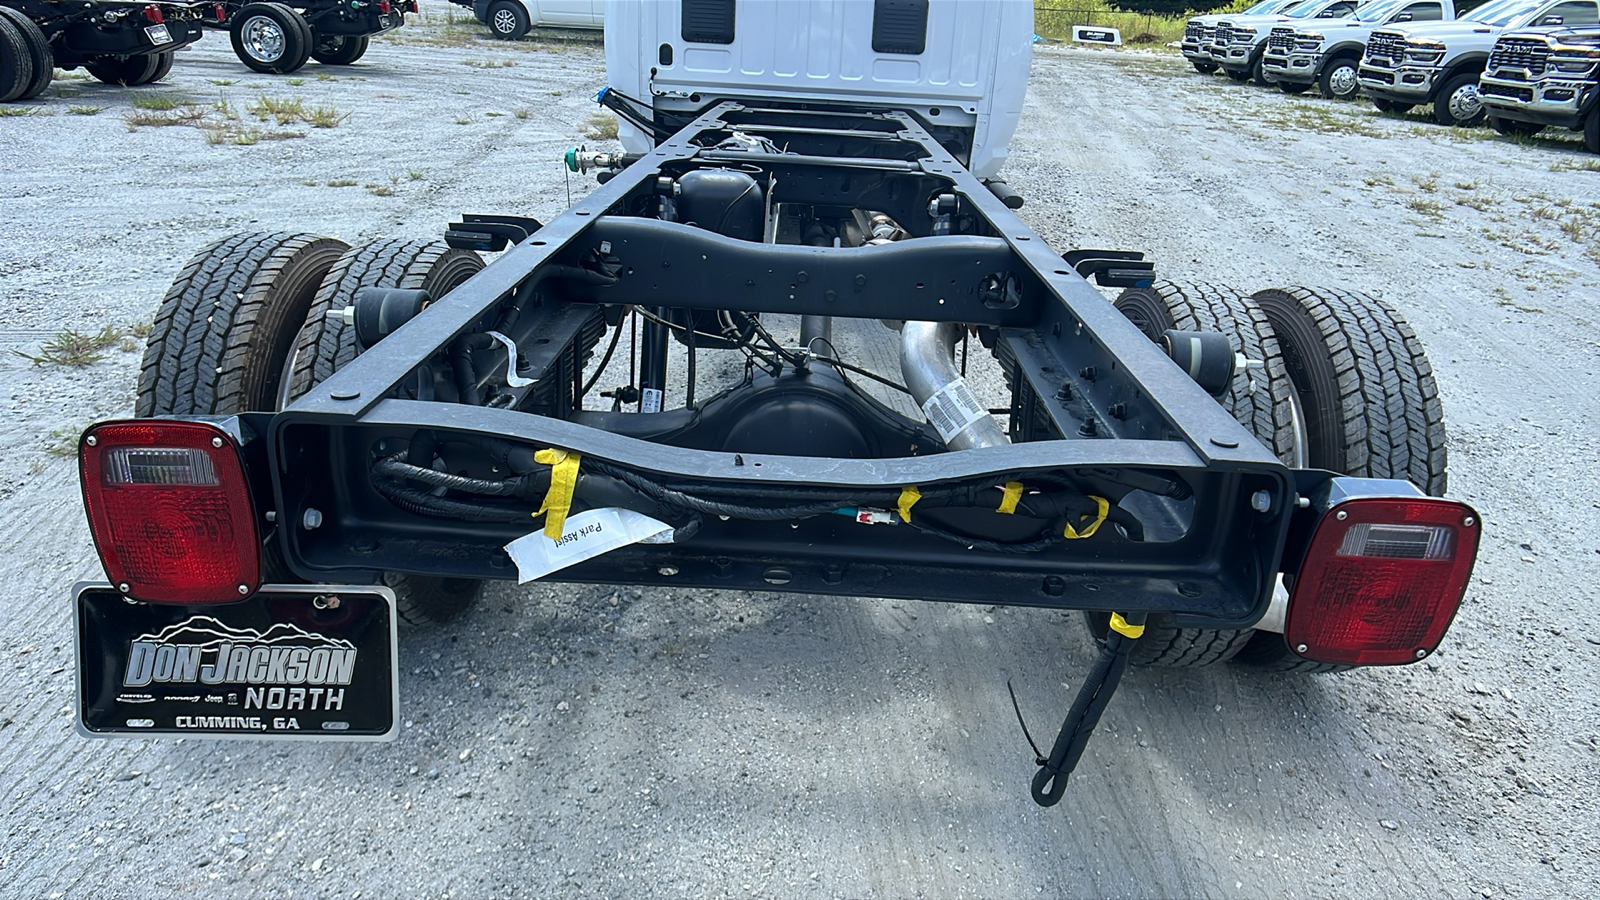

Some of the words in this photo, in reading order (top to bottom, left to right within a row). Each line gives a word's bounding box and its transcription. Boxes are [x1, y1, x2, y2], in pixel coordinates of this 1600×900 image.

[1504, 44, 1532, 54] RAM
[579, 522, 602, 538] Park
[553, 531, 578, 548] Assist
[123, 640, 201, 687] DON
[201, 641, 357, 686] JACKSON
[204, 694, 223, 704] Jeep
[244, 687, 345, 711] NORTH
[175, 716, 267, 732] CUMMING,
[273, 717, 300, 729] GA
